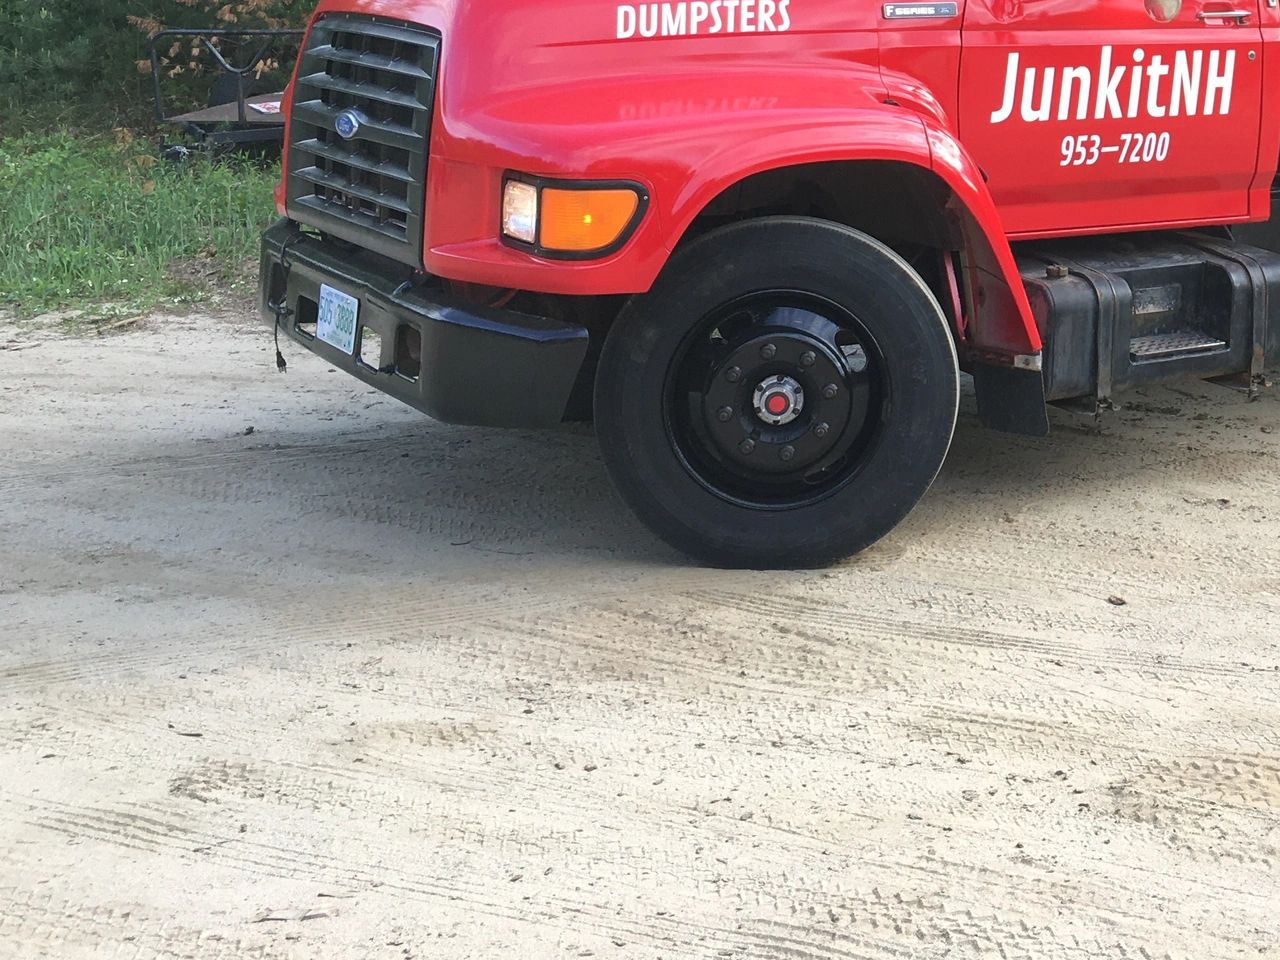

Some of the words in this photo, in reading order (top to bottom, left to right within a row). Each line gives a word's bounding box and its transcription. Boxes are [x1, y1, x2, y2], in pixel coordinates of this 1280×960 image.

[886, 5, 894, 17] F
[990, 45, 1236, 124] JunkitNH
[1060, 132, 1170, 167] 953-7200
